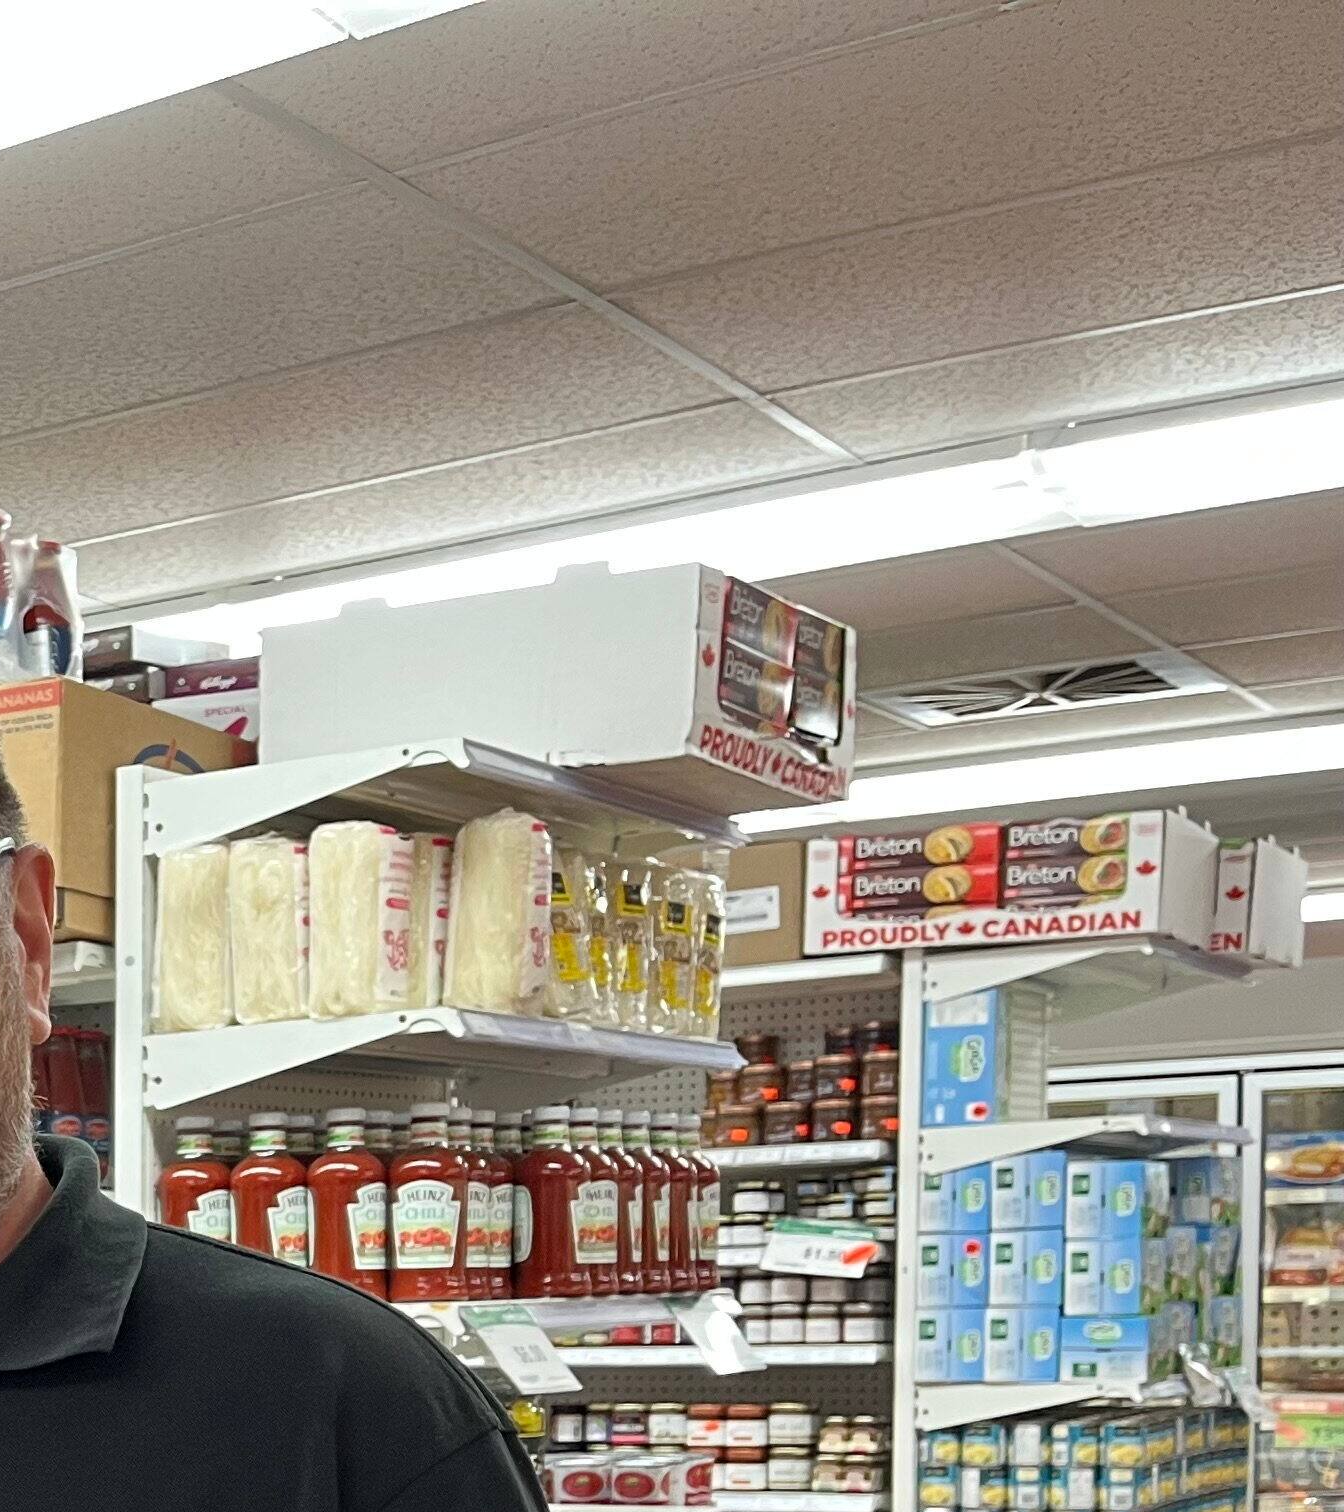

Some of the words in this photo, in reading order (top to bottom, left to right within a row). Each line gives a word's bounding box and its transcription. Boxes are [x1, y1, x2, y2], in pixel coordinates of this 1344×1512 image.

[855, 836, 923, 859] Breton
[855, 874, 921, 898] Breton
[821, 921, 949, 949] PROUDLY
[982, 909, 1141, 939] CANADIAN
[406, 1189, 446, 1203] HEINZ
